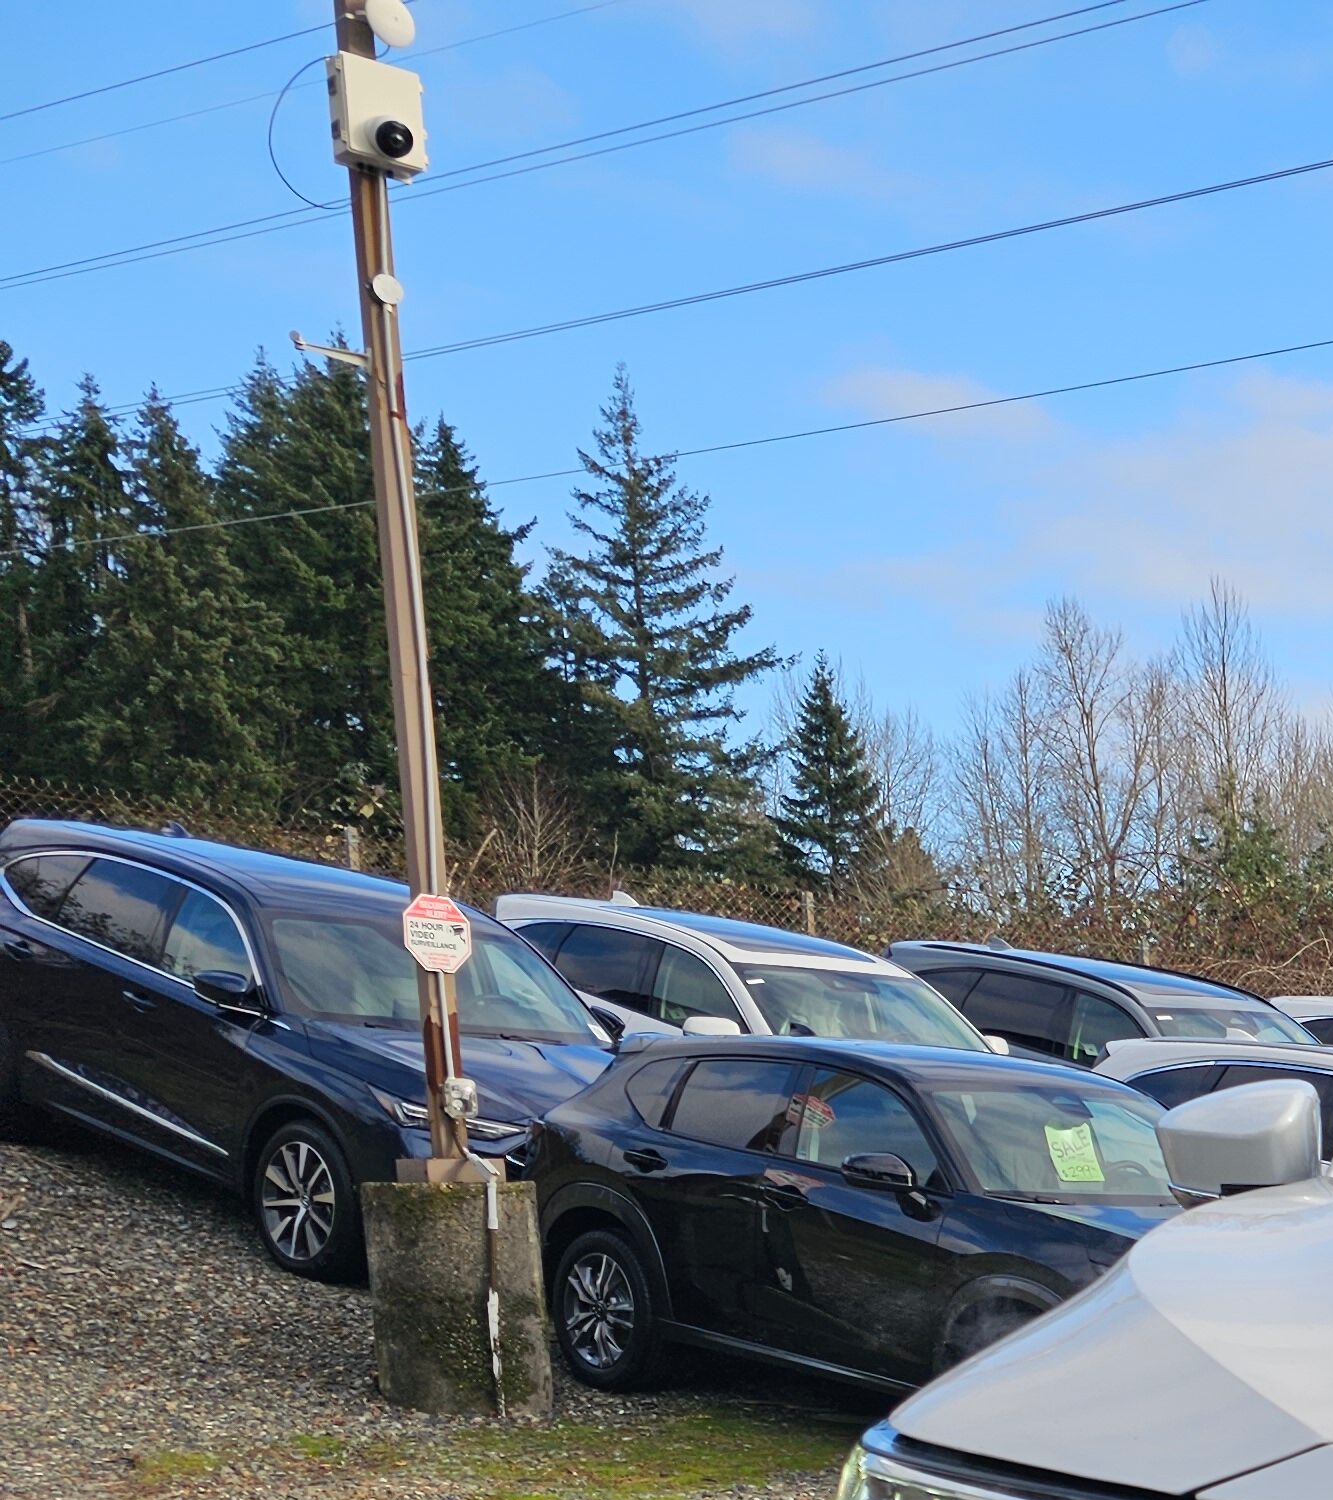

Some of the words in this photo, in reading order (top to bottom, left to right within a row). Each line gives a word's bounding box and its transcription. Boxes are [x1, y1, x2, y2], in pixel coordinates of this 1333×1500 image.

[409, 920, 419, 929] 24
[421, 921, 444, 931] HOUR
[410, 929, 435, 940] VIDEO
[410, 939, 457, 951] SURVEILLANCE
[1051, 1128, 1091, 1158] SALE
